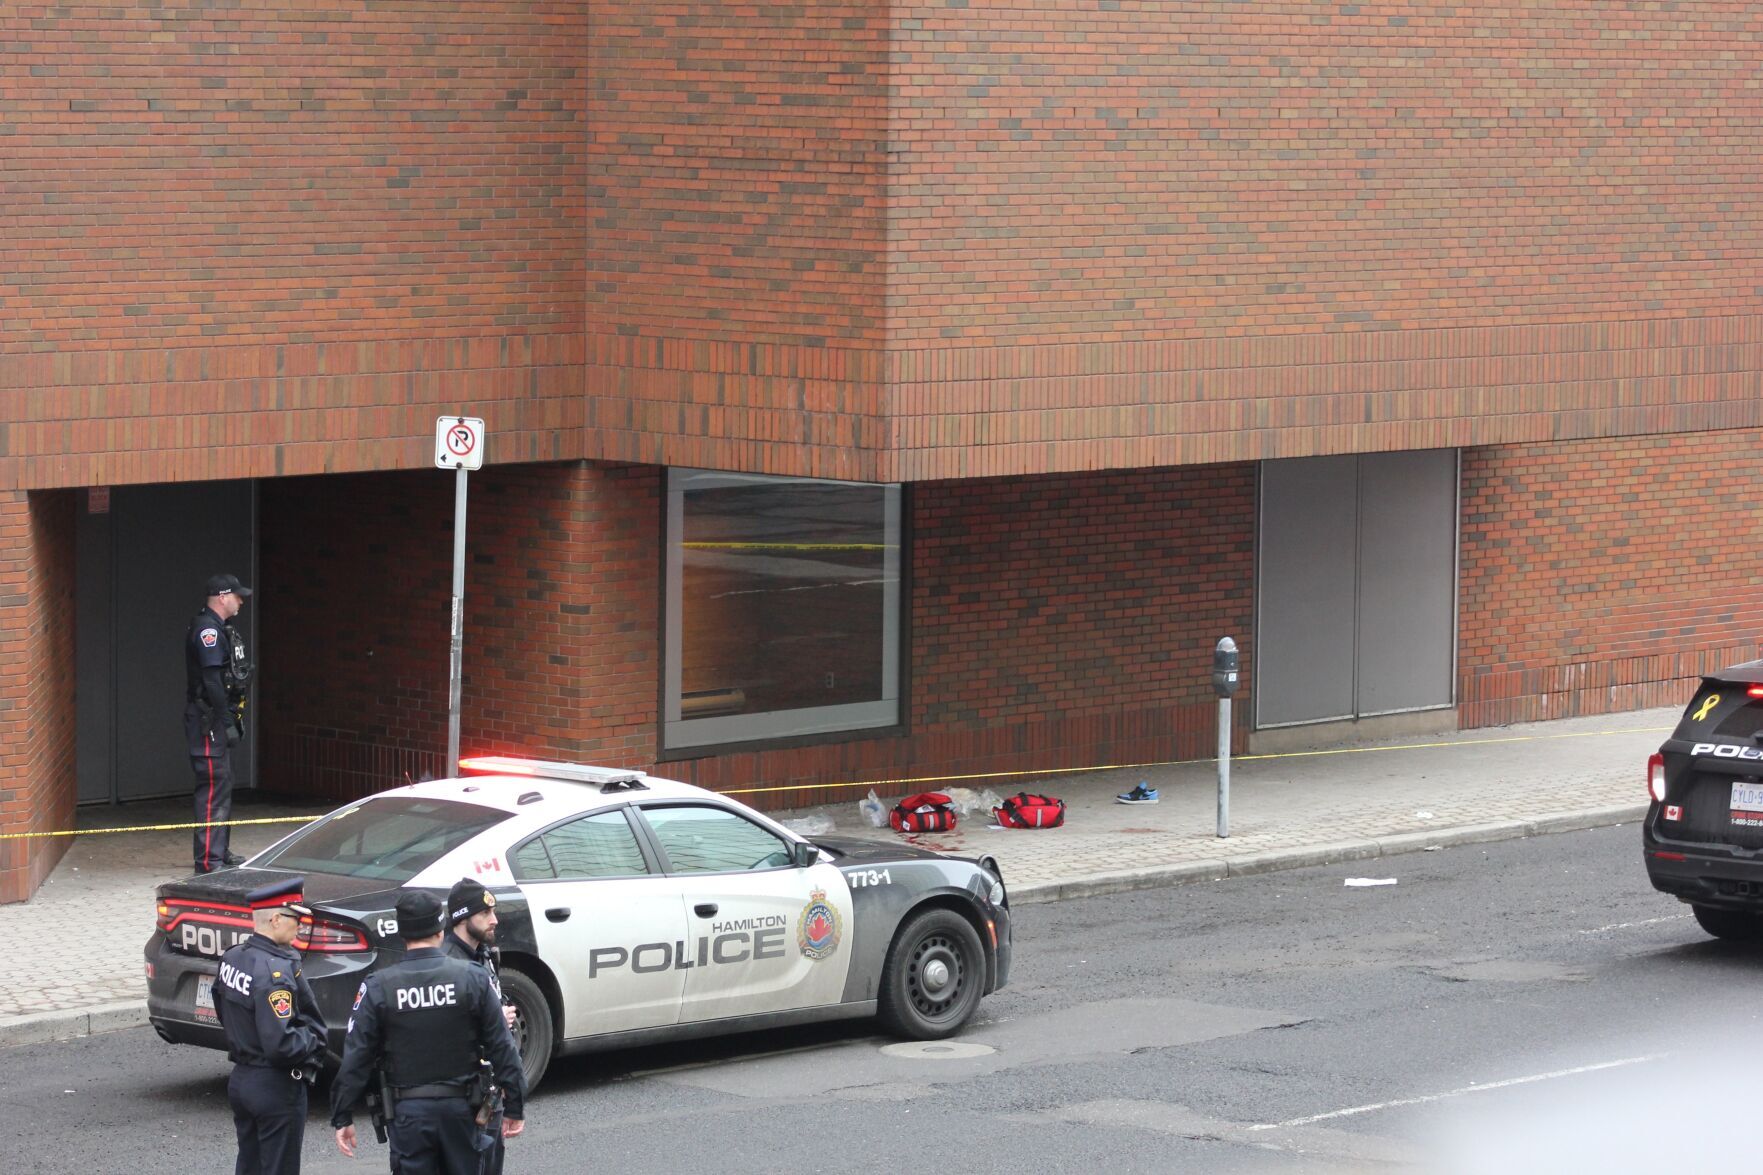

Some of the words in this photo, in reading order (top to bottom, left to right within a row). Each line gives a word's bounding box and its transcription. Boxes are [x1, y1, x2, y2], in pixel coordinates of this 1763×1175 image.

[848, 868, 892, 888] 773-1
[452, 906, 469, 919] POLICE
[807, 907, 833, 926] HAMILTON
[712, 914, 787, 933] HAMILTON
[182, 923, 254, 957] POLI
[588, 927, 786, 979] POLICE
[805, 947, 832, 959] POLICE
[220, 961, 253, 996] POLICE
[396, 983, 457, 1010] POLICE
